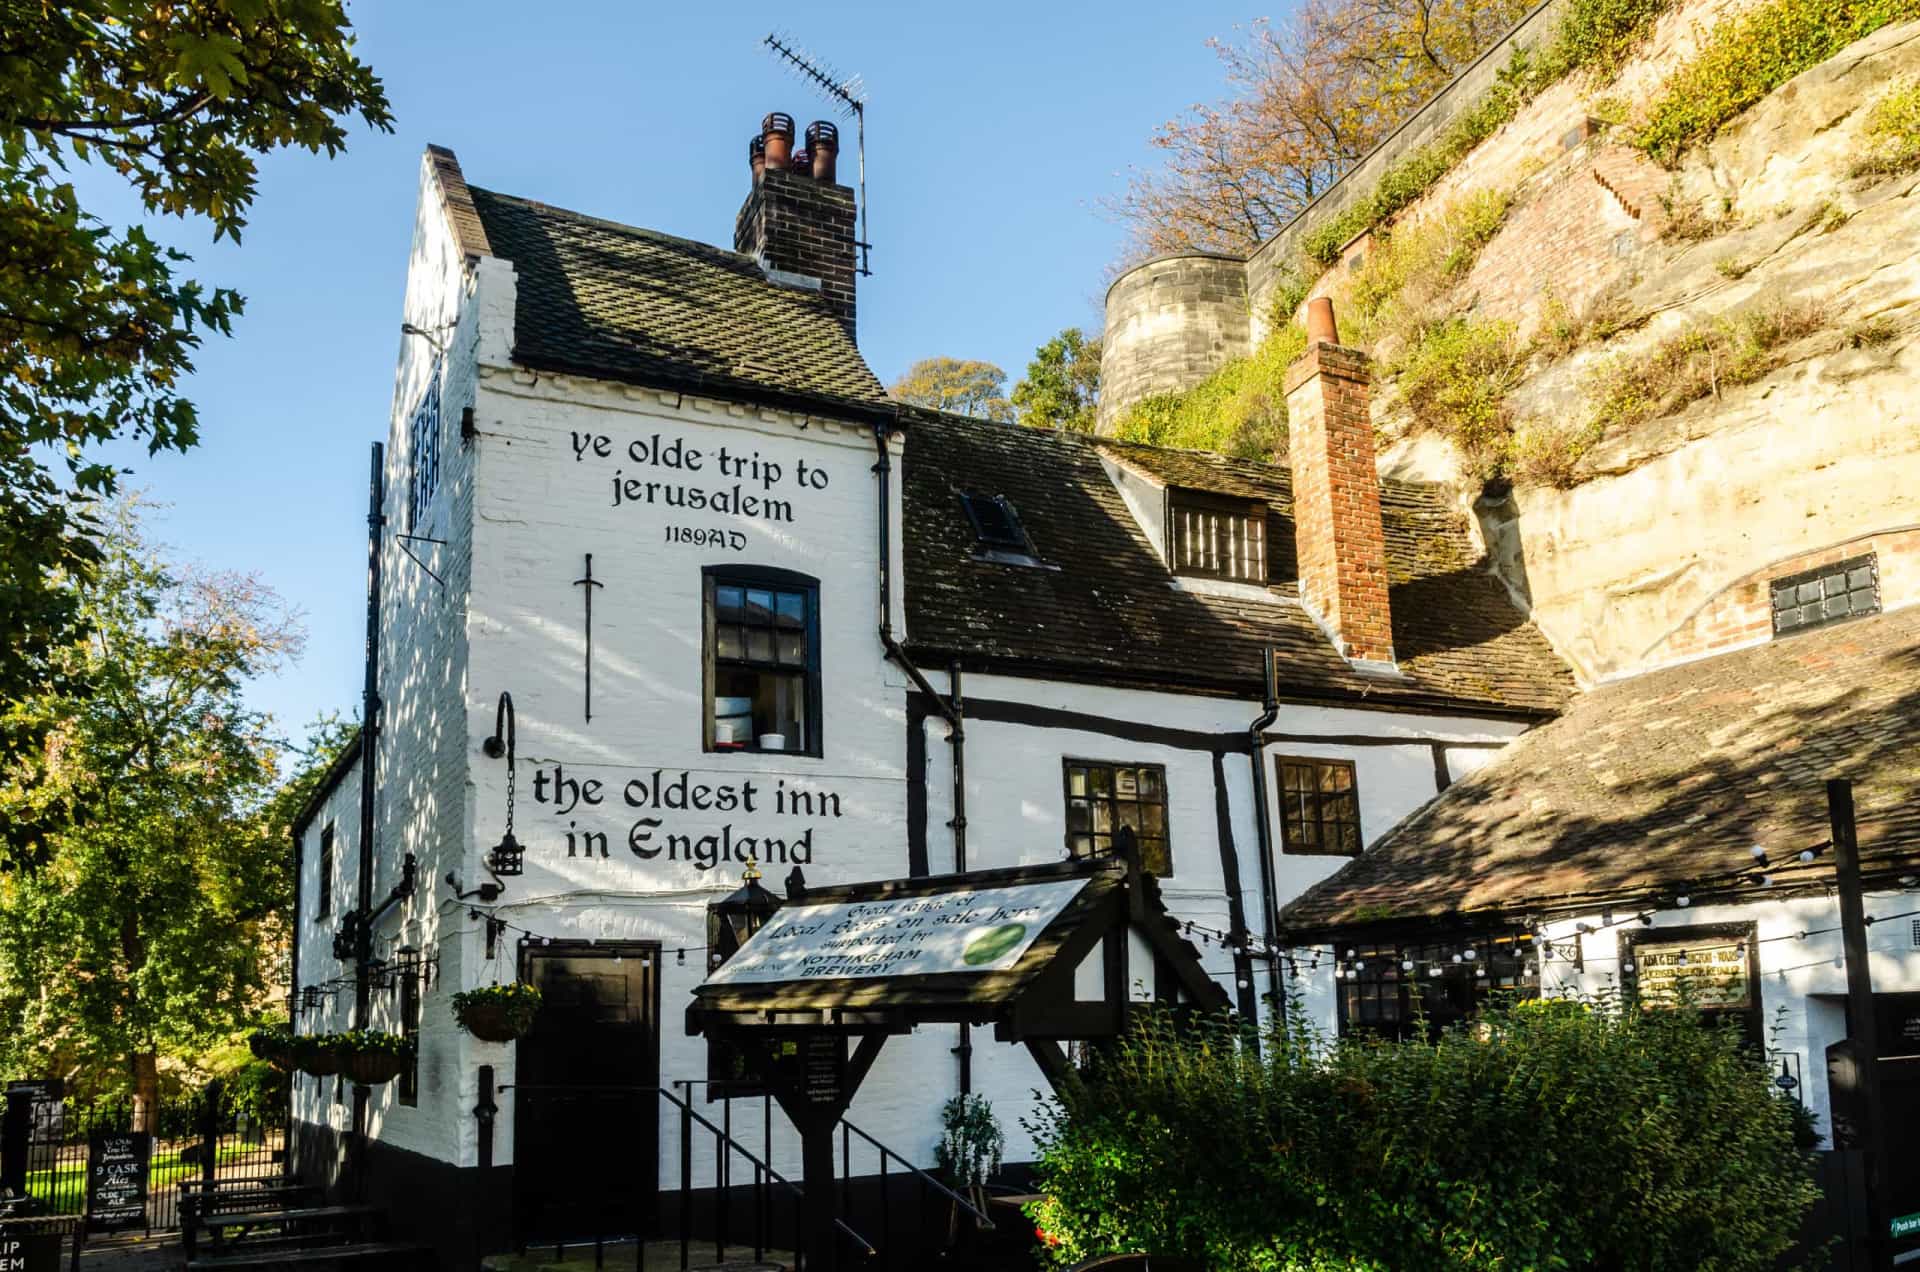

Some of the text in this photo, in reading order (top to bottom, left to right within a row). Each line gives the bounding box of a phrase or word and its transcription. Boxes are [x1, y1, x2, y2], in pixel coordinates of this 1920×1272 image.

[570, 431, 829, 490] ye olde trip to
[611, 470, 795, 523] jerusalem
[533, 764, 843, 818] the oldest inn
[565, 817, 814, 871] in England
[768, 921, 826, 940] Local
[895, 917, 925, 930] on
[932, 908, 980, 926] sale
[799, 949, 923, 967] NOTTINGHAM
[107, 1163, 140, 1175] CASK
